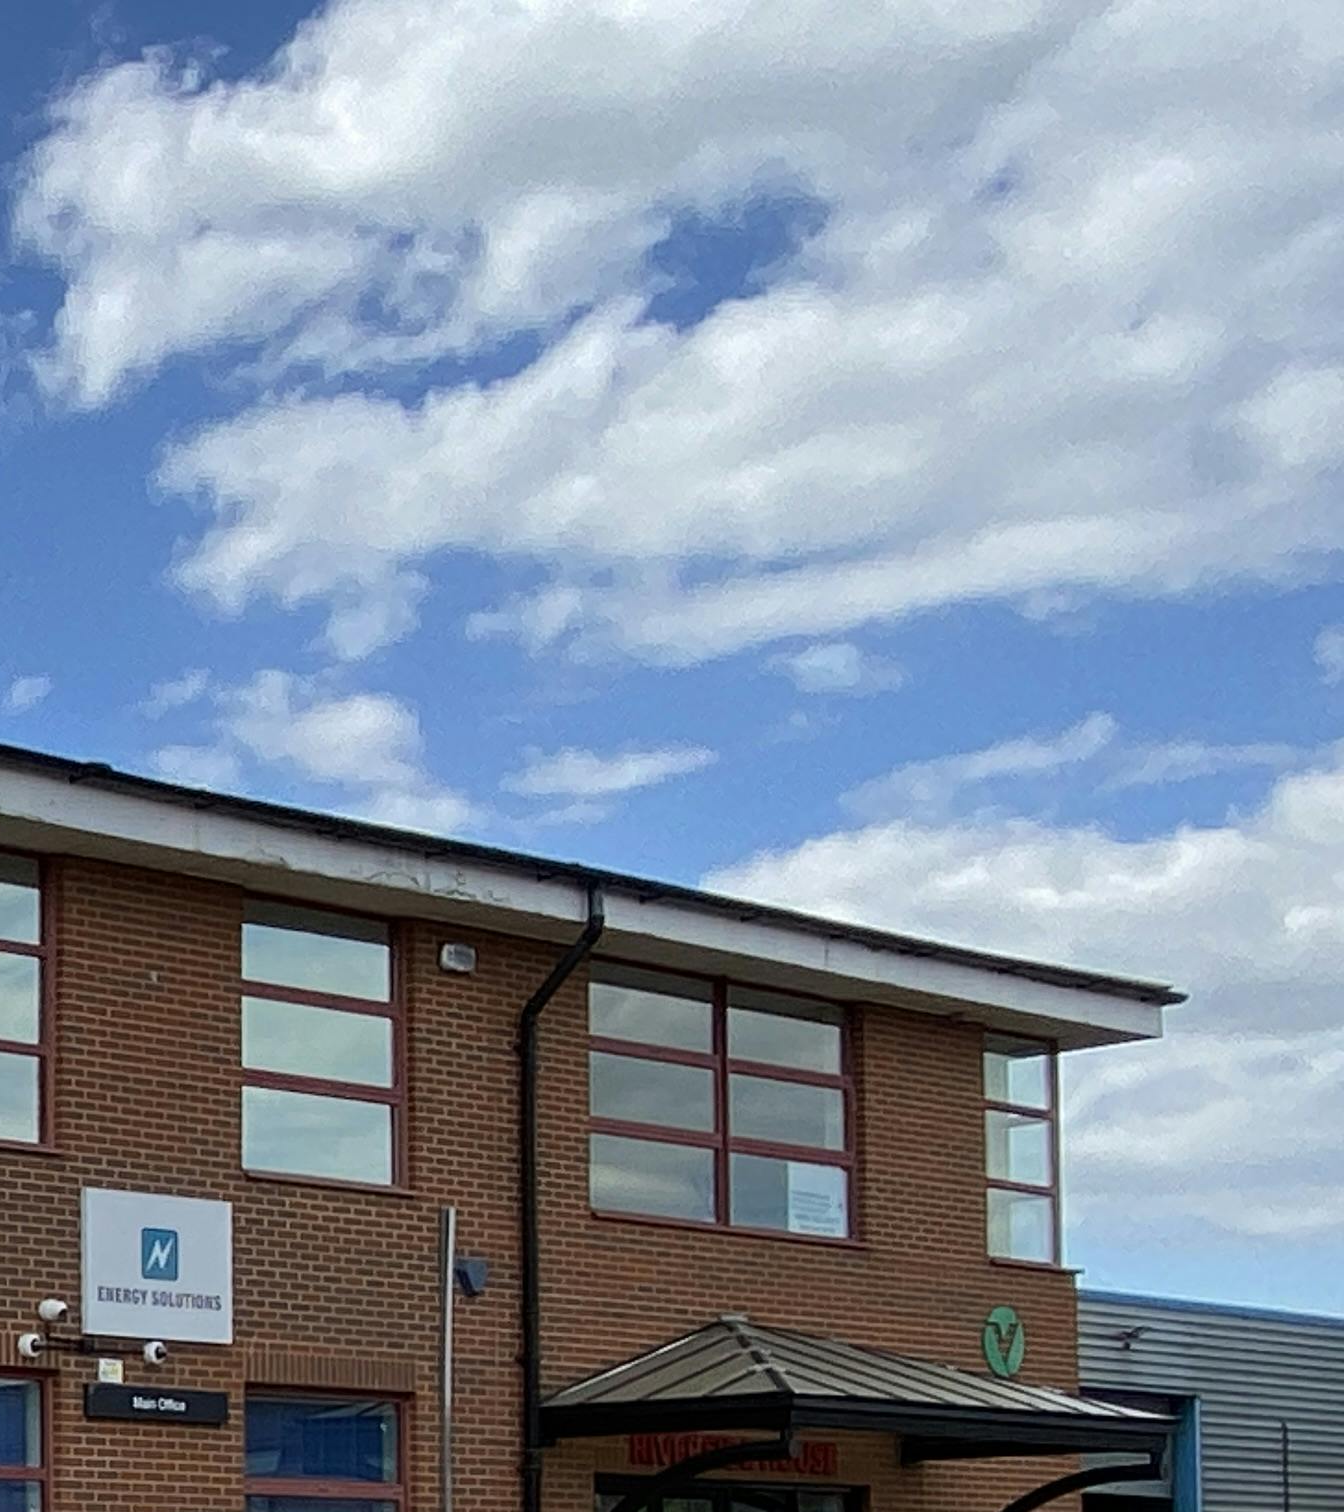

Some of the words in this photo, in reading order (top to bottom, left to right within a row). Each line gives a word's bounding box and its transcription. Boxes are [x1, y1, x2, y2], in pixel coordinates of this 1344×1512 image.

[96, 1285, 148, 1306] ENERGY
[150, 1289, 222, 1312] SOLUTIONS
[132, 1395, 157, 1410] Main
[157, 1396, 187, 1413] Office
